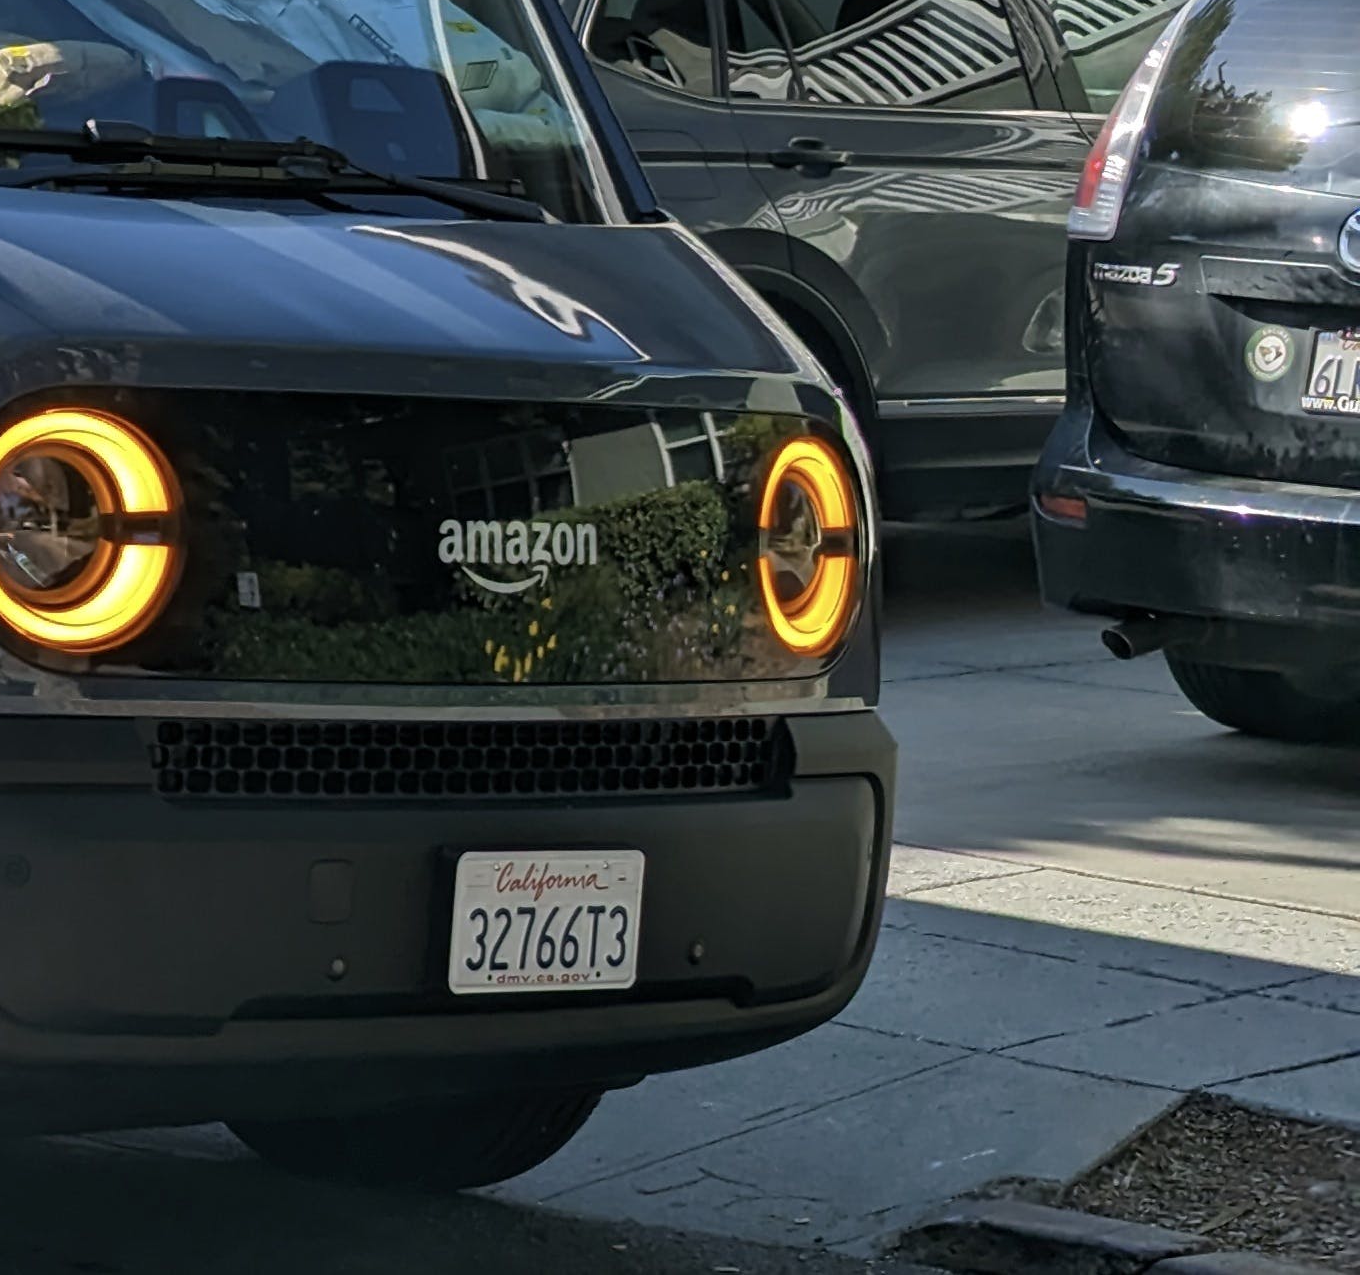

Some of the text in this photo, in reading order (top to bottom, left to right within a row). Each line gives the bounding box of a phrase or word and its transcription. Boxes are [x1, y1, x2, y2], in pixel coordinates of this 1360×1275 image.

[438, 519, 597, 566] amazon
[496, 862, 608, 902] California
[465, 905, 628, 971] 32766T3
[496, 972, 591, 984] dmv.ca.gov
